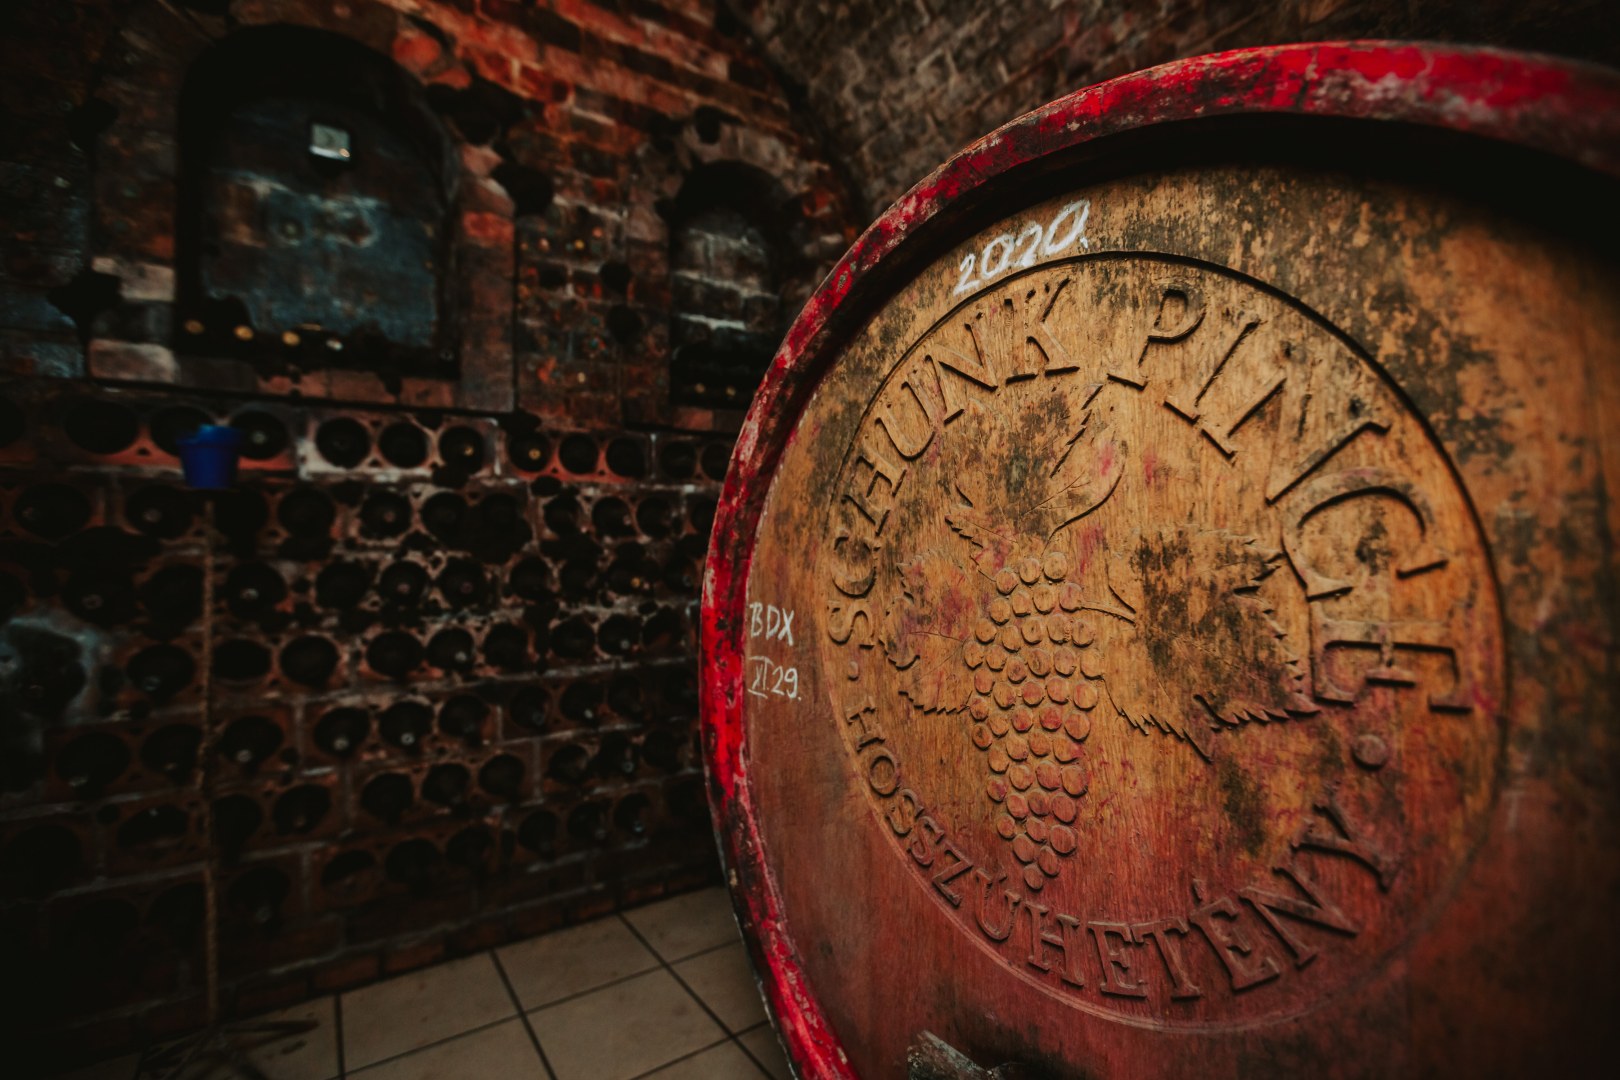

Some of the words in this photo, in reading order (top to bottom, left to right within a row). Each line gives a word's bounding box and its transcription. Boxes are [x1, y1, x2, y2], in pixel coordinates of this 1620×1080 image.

[953, 199, 1091, 297] 2020.
[826, 276, 1080, 650] SCHUNK
[1106, 275, 1475, 716] PINCE
[749, 602, 795, 647] BDX
[846, 695, 1400, 1001] HOSSZÚHETÉNY
